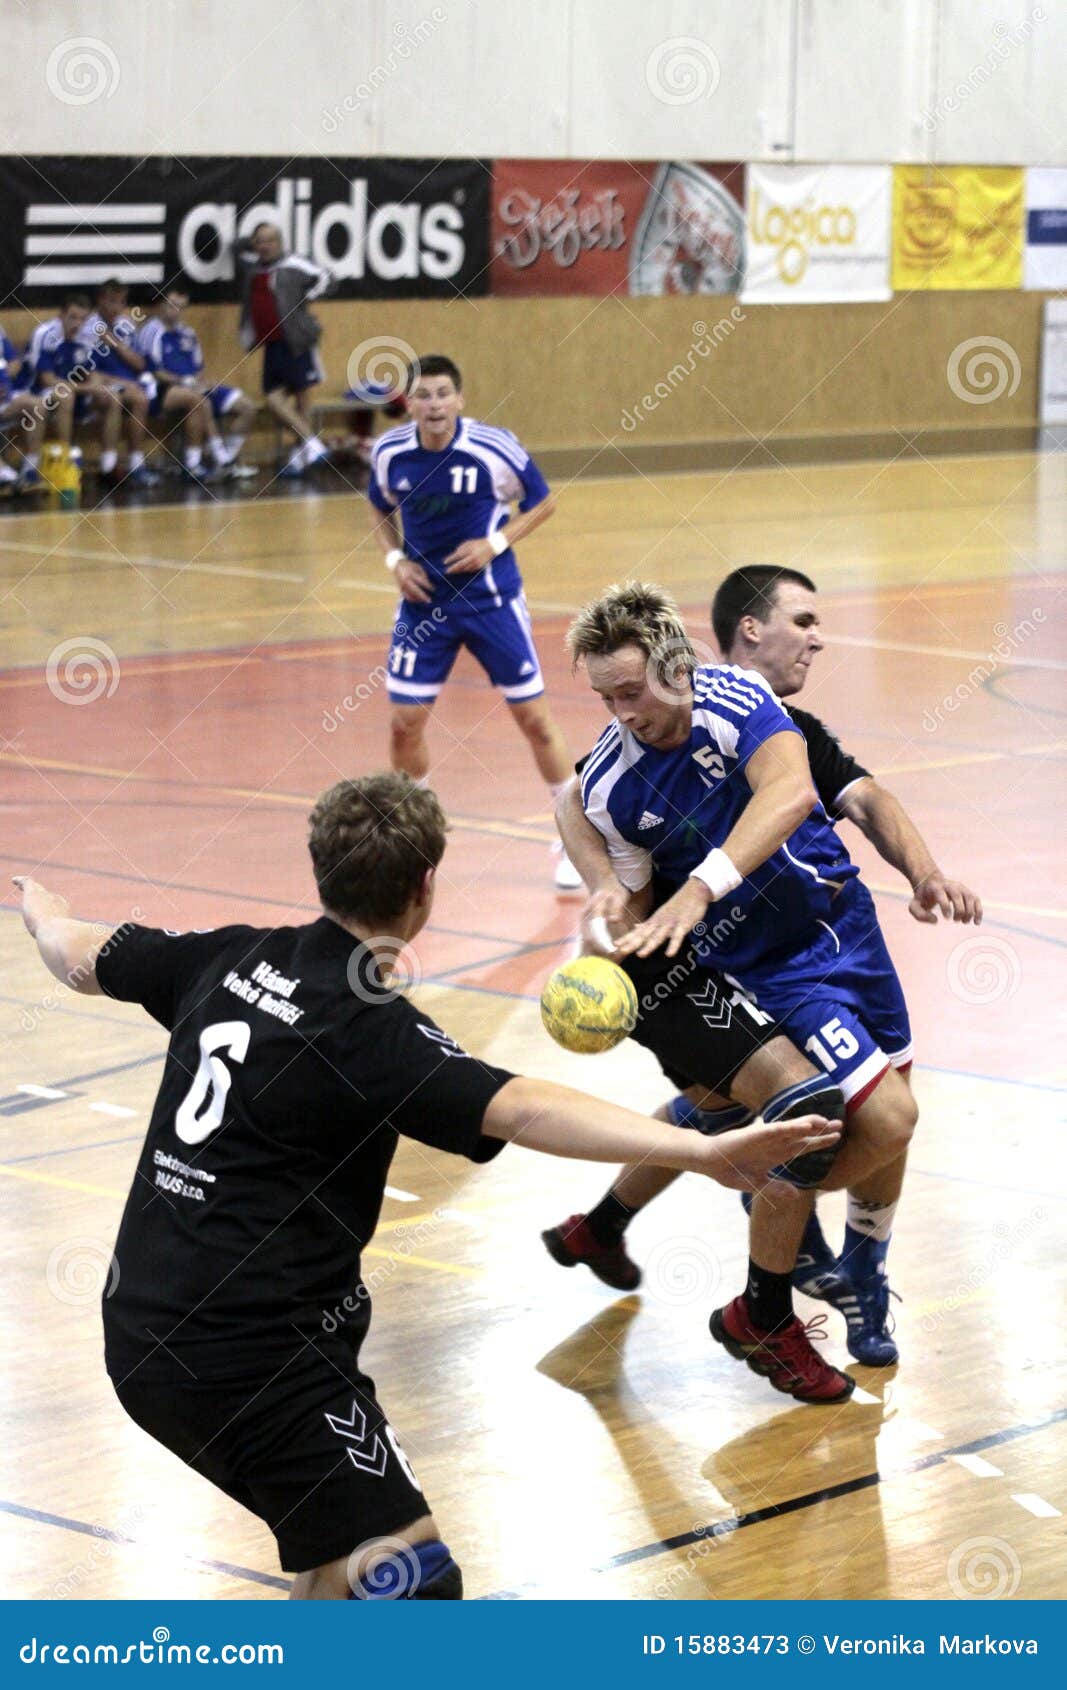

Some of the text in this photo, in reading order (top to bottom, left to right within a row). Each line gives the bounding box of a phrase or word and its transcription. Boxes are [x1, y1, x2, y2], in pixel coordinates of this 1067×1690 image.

[178, 178, 465, 284] adidas
[449, 465, 479, 495] 11
[390, 645, 418, 678] 11
[805, 1017, 860, 1074] 15
[175, 1021, 251, 1145] 6
